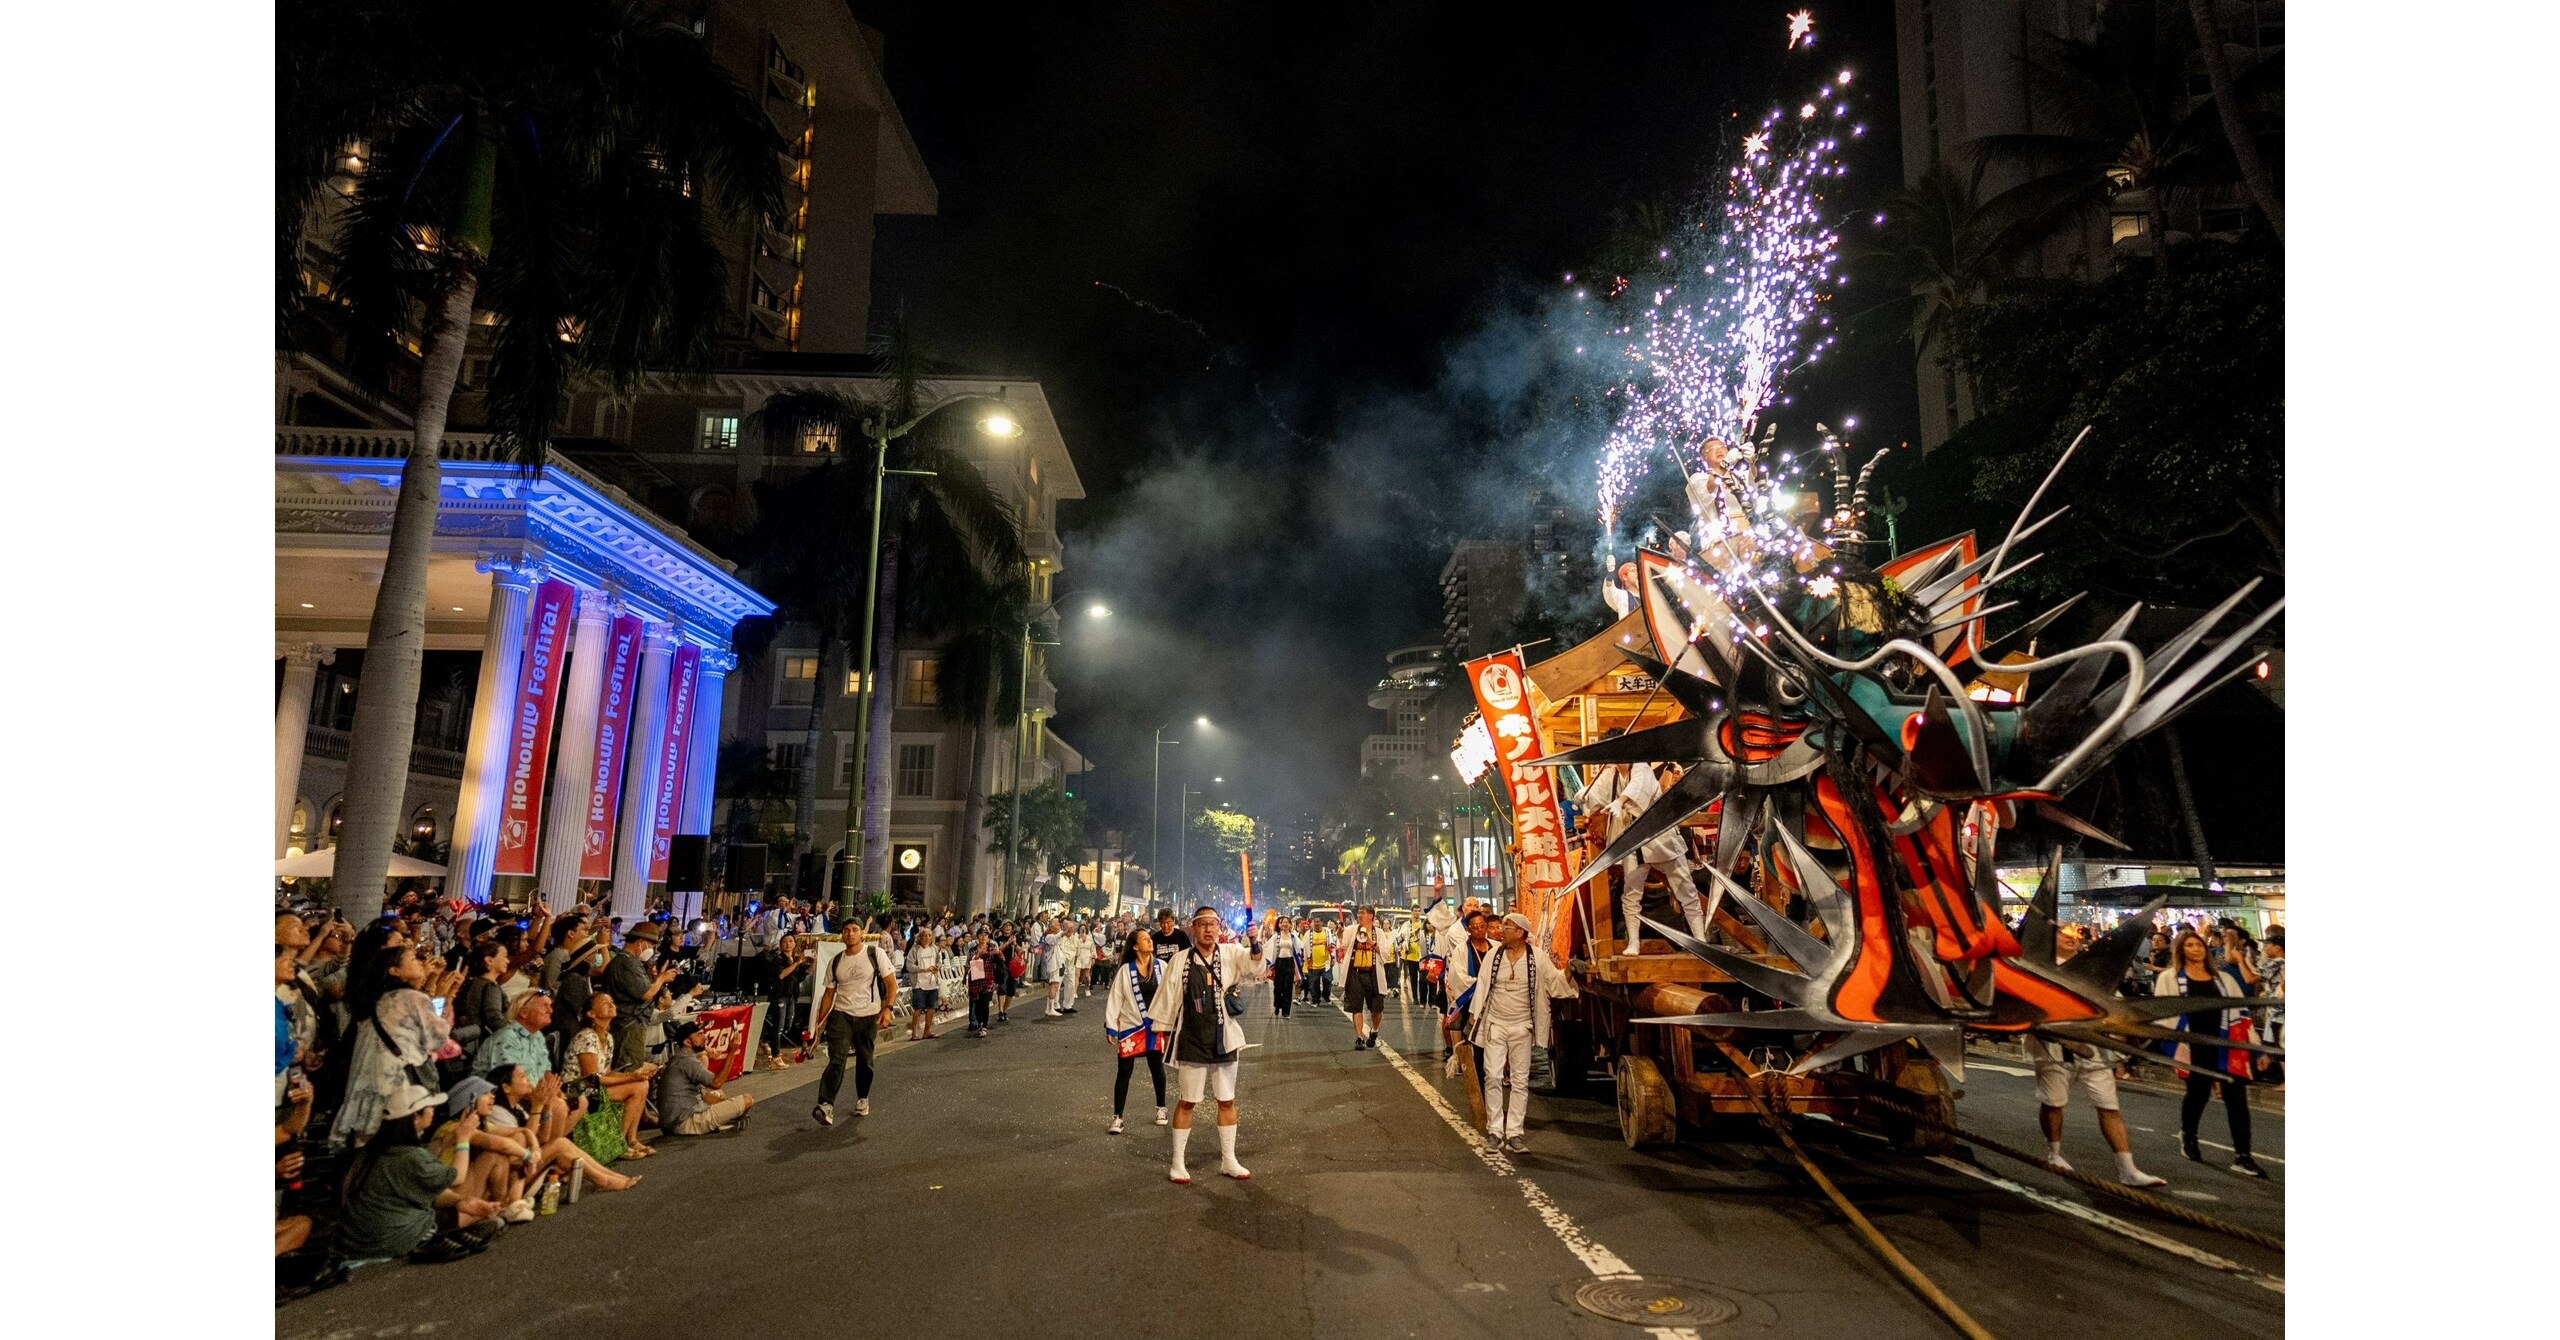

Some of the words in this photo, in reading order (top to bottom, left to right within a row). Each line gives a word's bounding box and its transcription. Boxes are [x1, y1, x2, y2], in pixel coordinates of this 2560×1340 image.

[511, 702, 539, 810] HONOLULU
[591, 724, 614, 821] HONOLULU
[658, 742, 678, 829] HONOLULU
[1495, 713, 1564, 884] ホノルル大蛇山
